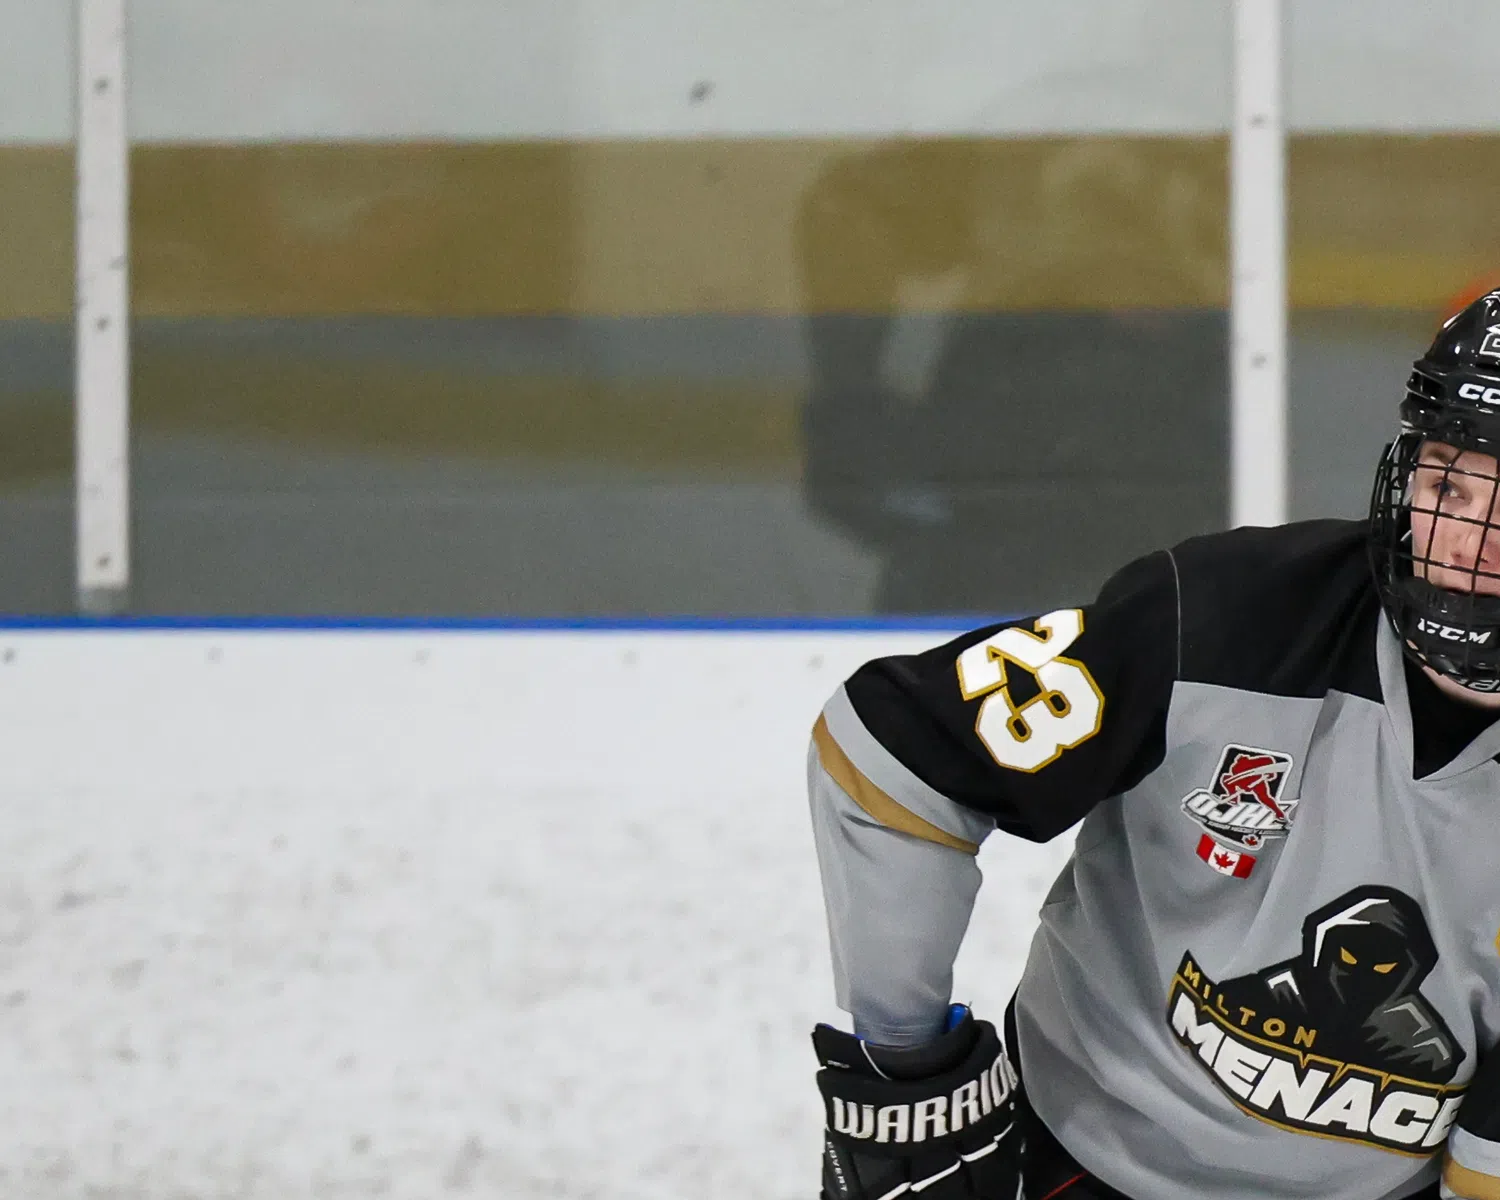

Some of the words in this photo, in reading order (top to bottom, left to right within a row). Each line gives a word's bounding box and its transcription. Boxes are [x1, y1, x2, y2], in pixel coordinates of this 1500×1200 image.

[956, 609, 1105, 773] 23
[1417, 617, 1492, 645] CCM
[1184, 961, 1316, 1048] MILTON
[1171, 992, 1465, 1148] MENACE
